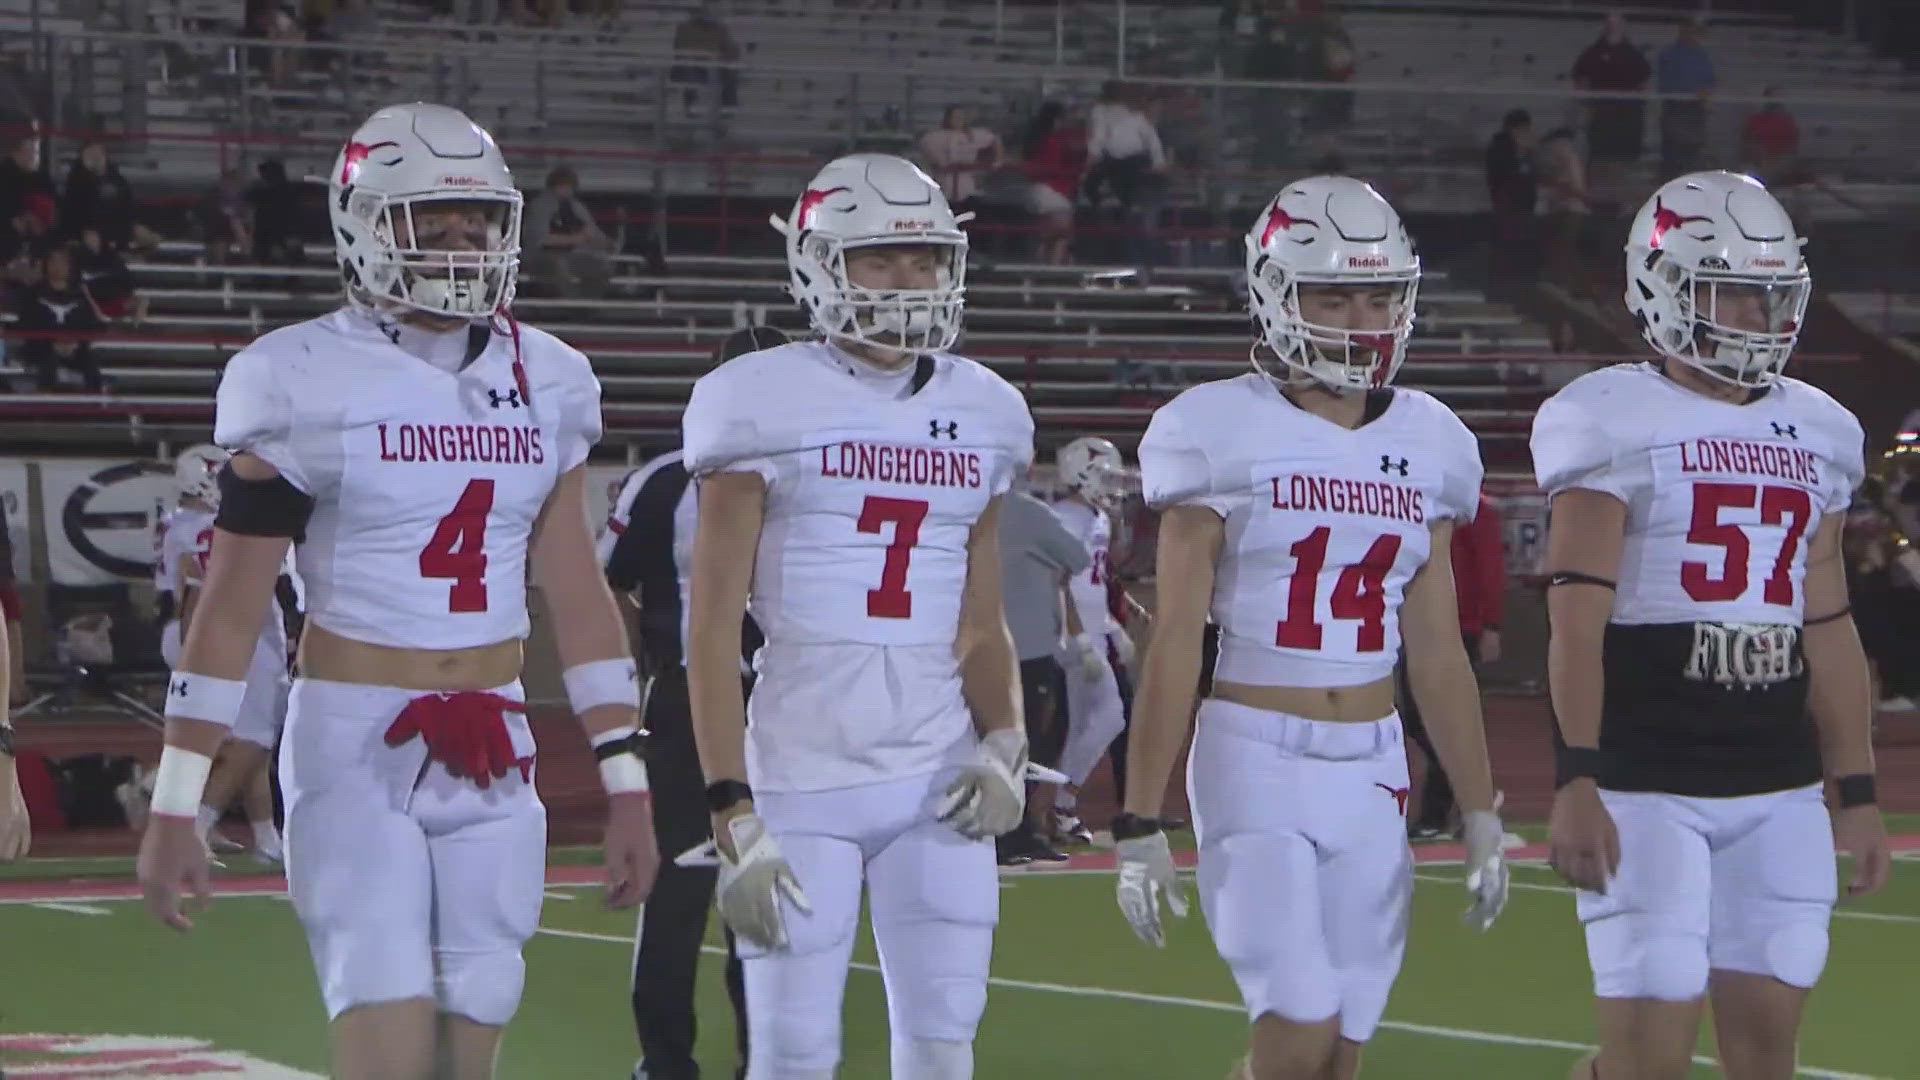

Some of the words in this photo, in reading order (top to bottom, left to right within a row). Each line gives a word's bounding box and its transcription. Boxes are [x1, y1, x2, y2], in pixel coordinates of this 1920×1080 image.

[1349, 256, 1389, 268] Riddell
[378, 423, 543, 465] LONGHORNS
[822, 443, 981, 488] LONGHORNS
[1680, 439, 1819, 486] LONGHORNS
[1272, 475, 1424, 523] LONGHORNS
[419, 478, 495, 612] 4
[857, 495, 929, 619] 7
[1681, 484, 1811, 605] 57
[1276, 527, 1402, 652] 14
